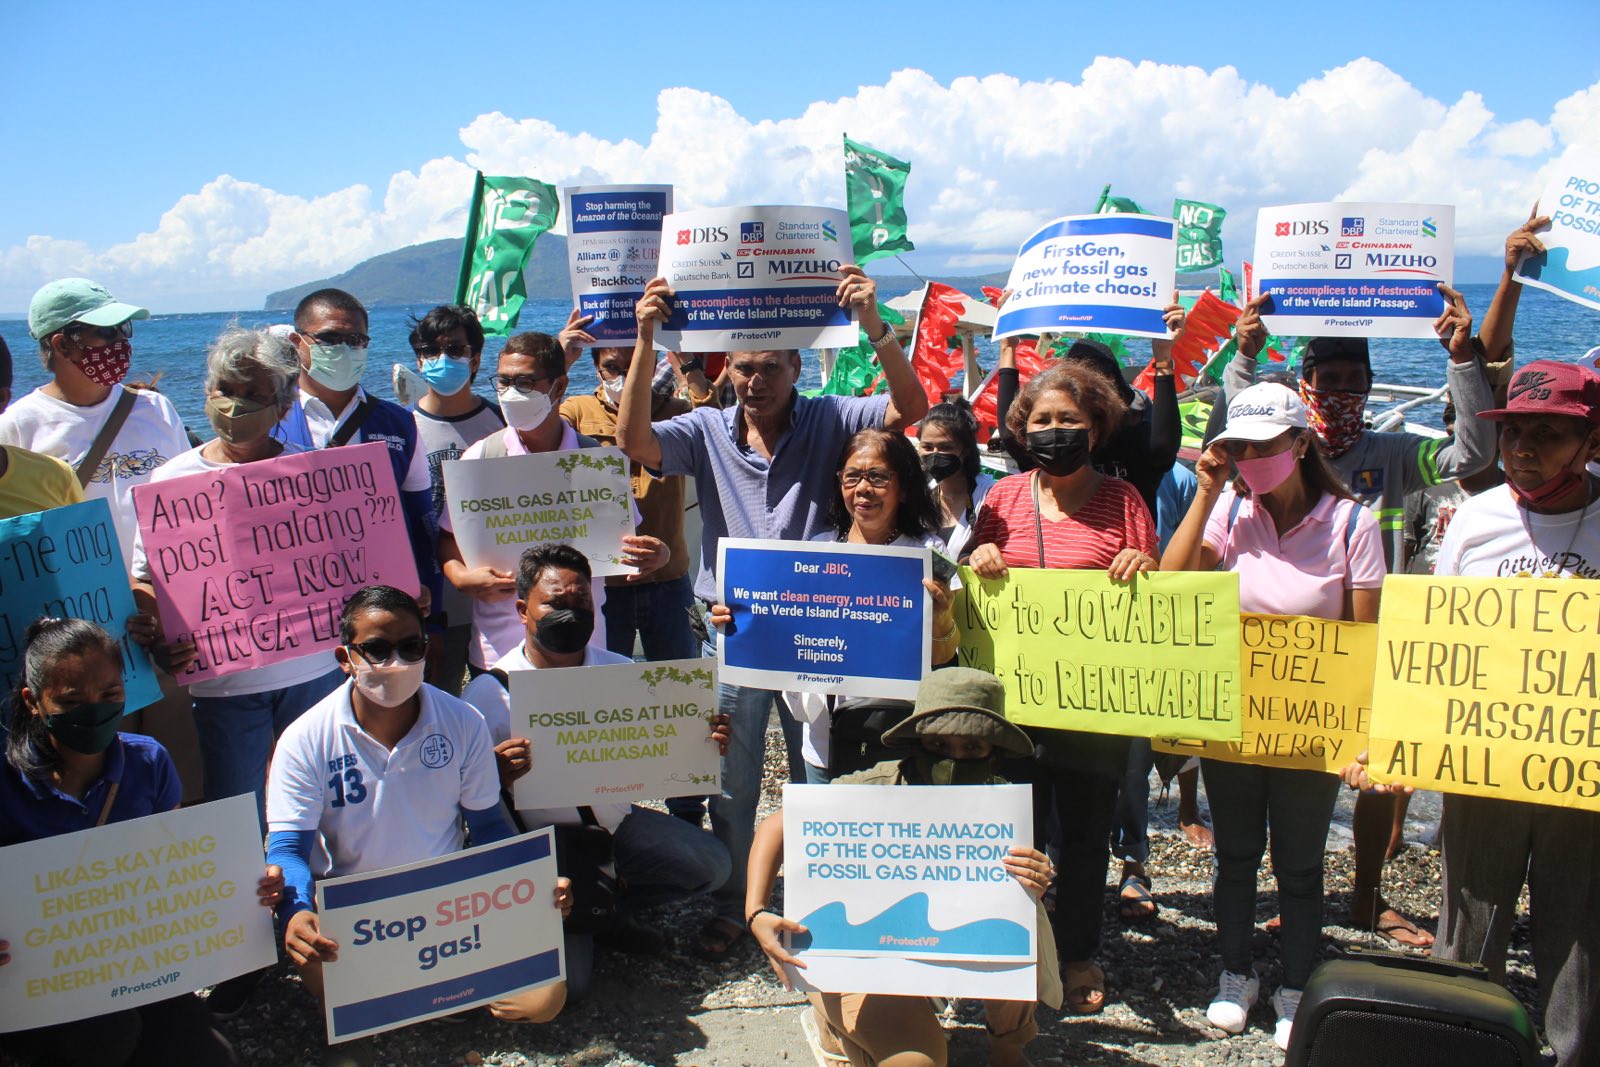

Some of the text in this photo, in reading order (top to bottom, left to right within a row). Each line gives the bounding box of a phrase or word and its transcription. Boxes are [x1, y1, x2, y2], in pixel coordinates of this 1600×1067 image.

[585, 200, 651, 212] Stop harming the
[1559, 194, 1584, 209] OF
[576, 211, 662, 222] Amazon of the Oceans!
[1179, 204, 1214, 229] NO
[1379, 218, 1419, 227] Standard
[693, 226, 729, 243] DBS
[778, 221, 819, 231] Standard
[1293, 220, 1329, 235] DBS
[1342, 227, 1363, 236] DBP
[1375, 227, 1419, 236] Chartered
[742, 233, 763, 243] DBP
[775, 232, 820, 240] Chartered
[577, 252, 607, 261] Allianz
[1043, 242, 1125, 259] FirstGen,
[1178, 242, 1214, 267] GAS
[768, 260, 841, 275] MIZUHO
[1272, 262, 1329, 270] Deutsche Bank
[1365, 253, 1437, 268] MIZUHO
[576, 266, 610, 274] Schroders
[673, 271, 732, 282] Deutsche Bank
[1022, 260, 1148, 282] new fossil gas
[591, 275, 647, 287] BlackRock
[1012, 279, 1157, 301] is climate chaos!
[1270, 286, 1433, 297] are accomplices to the destruction
[583, 298, 633, 310] Back off fossil
[673, 293, 839, 309] are accomplices to the destruction
[1282, 297, 1418, 310] of the Verde Island Passage.
[595, 309, 633, 320] LNG in the
[687, 308, 825, 321] of the Verde Island Passage.
[1324, 319, 1373, 327] #ProtectVIP
[731, 331, 782, 340] #ProtectVIP
[1229, 403, 1275, 419] Titleist
[151, 461, 377, 534] Ano? hanggang
[461, 487, 615, 512] FOSSIL GAS AT LNG,
[485, 507, 594, 529] MAPANIRA SA
[158, 495, 397, 584] post nalang???
[496, 524, 588, 545] KALIKASAN!
[66, 522, 113, 566] ang
[794, 561, 852, 577] Dear JBIC,
[1497, 552, 1558, 577] City of
[201, 564, 274, 622] ACT
[733, 588, 913, 608] We want clean energy, not LNG in
[751, 603, 893, 623] the Verde Island Passage.
[965, 583, 1000, 631] No
[1053, 588, 1216, 646] JOWABLE
[793, 634, 848, 650] Sincerely,
[1242, 616, 1349, 656] OSSIL
[797, 649, 844, 663] Filipinos
[1250, 651, 1326, 684] FUEL
[1388, 640, 1600, 699] VERDE ISLA
[797, 674, 844, 684] #ProtectVIP
[1055, 659, 1233, 721] RENEWABLE
[529, 702, 701, 728] FOSSIL GAS AT LNG,
[556, 724, 677, 746] MAPANIRA SA
[567, 742, 668, 764] KALIKASAN!
[1239, 731, 1344, 761] ENERGY
[1386, 740, 1600, 798] AT ALL COS
[328, 768, 367, 808] 13
[594, 783, 645, 794] #ProtectVIP
[802, 821, 1014, 839] PROTECT THE AMAZON
[805, 842, 1010, 861] OF THE OCEANS FROM
[34, 835, 217, 894] LIKAS-KAYANG
[807, 863, 872, 880] FOSSIL
[875, 864, 919, 881] GAS
[921, 866, 962, 882] AND
[42, 860, 217, 919] ENERHIYA ANG
[23, 880, 236, 948] GAMITIN, HUWAG
[353, 878, 536, 946] Stop SEDCO
[53, 911, 219, 968] MAPANIRANG
[418, 924, 482, 971] gas!
[879, 935, 940, 947] #ProtectVIP
[26, 924, 246, 998] ENERHIYA NG LNG!
[110, 971, 181, 998] #ProtectVIP
[432, 988, 475, 1005] #ProtectVIP
